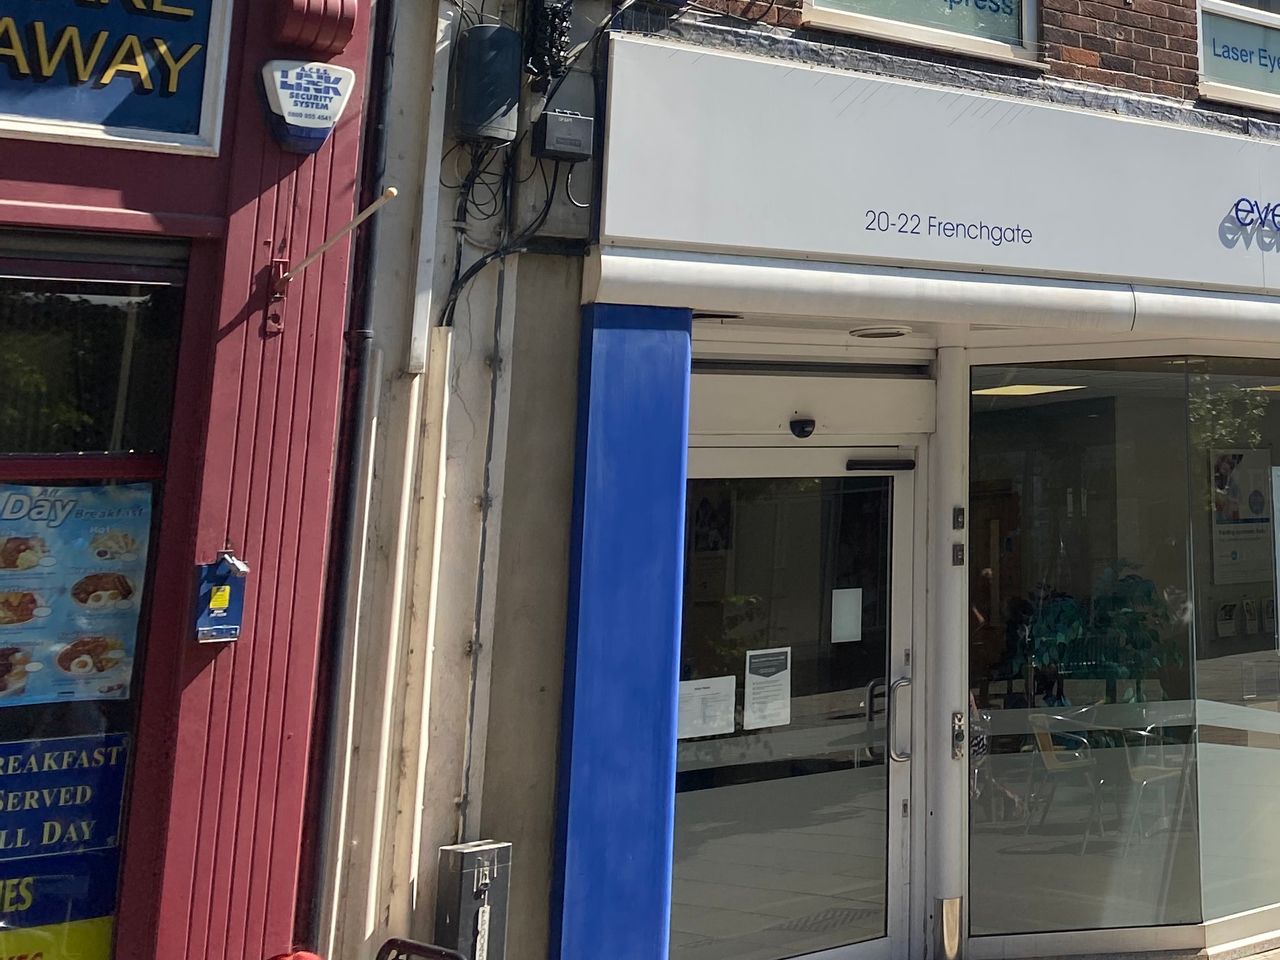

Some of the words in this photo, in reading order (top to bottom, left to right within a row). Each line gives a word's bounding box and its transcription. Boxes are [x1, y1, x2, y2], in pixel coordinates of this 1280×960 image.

[0, 16, 203, 93] AWAY
[1212, 38, 1254, 65] Laser
[289, 92, 334, 103] SECURITY
[293, 100, 329, 110] SYSTEM
[865, 210, 921, 235] 20-22
[928, 216, 1033, 247] Frenchgate
[1, 493, 77, 528] Day
[41, 820, 97, 845] DAY
